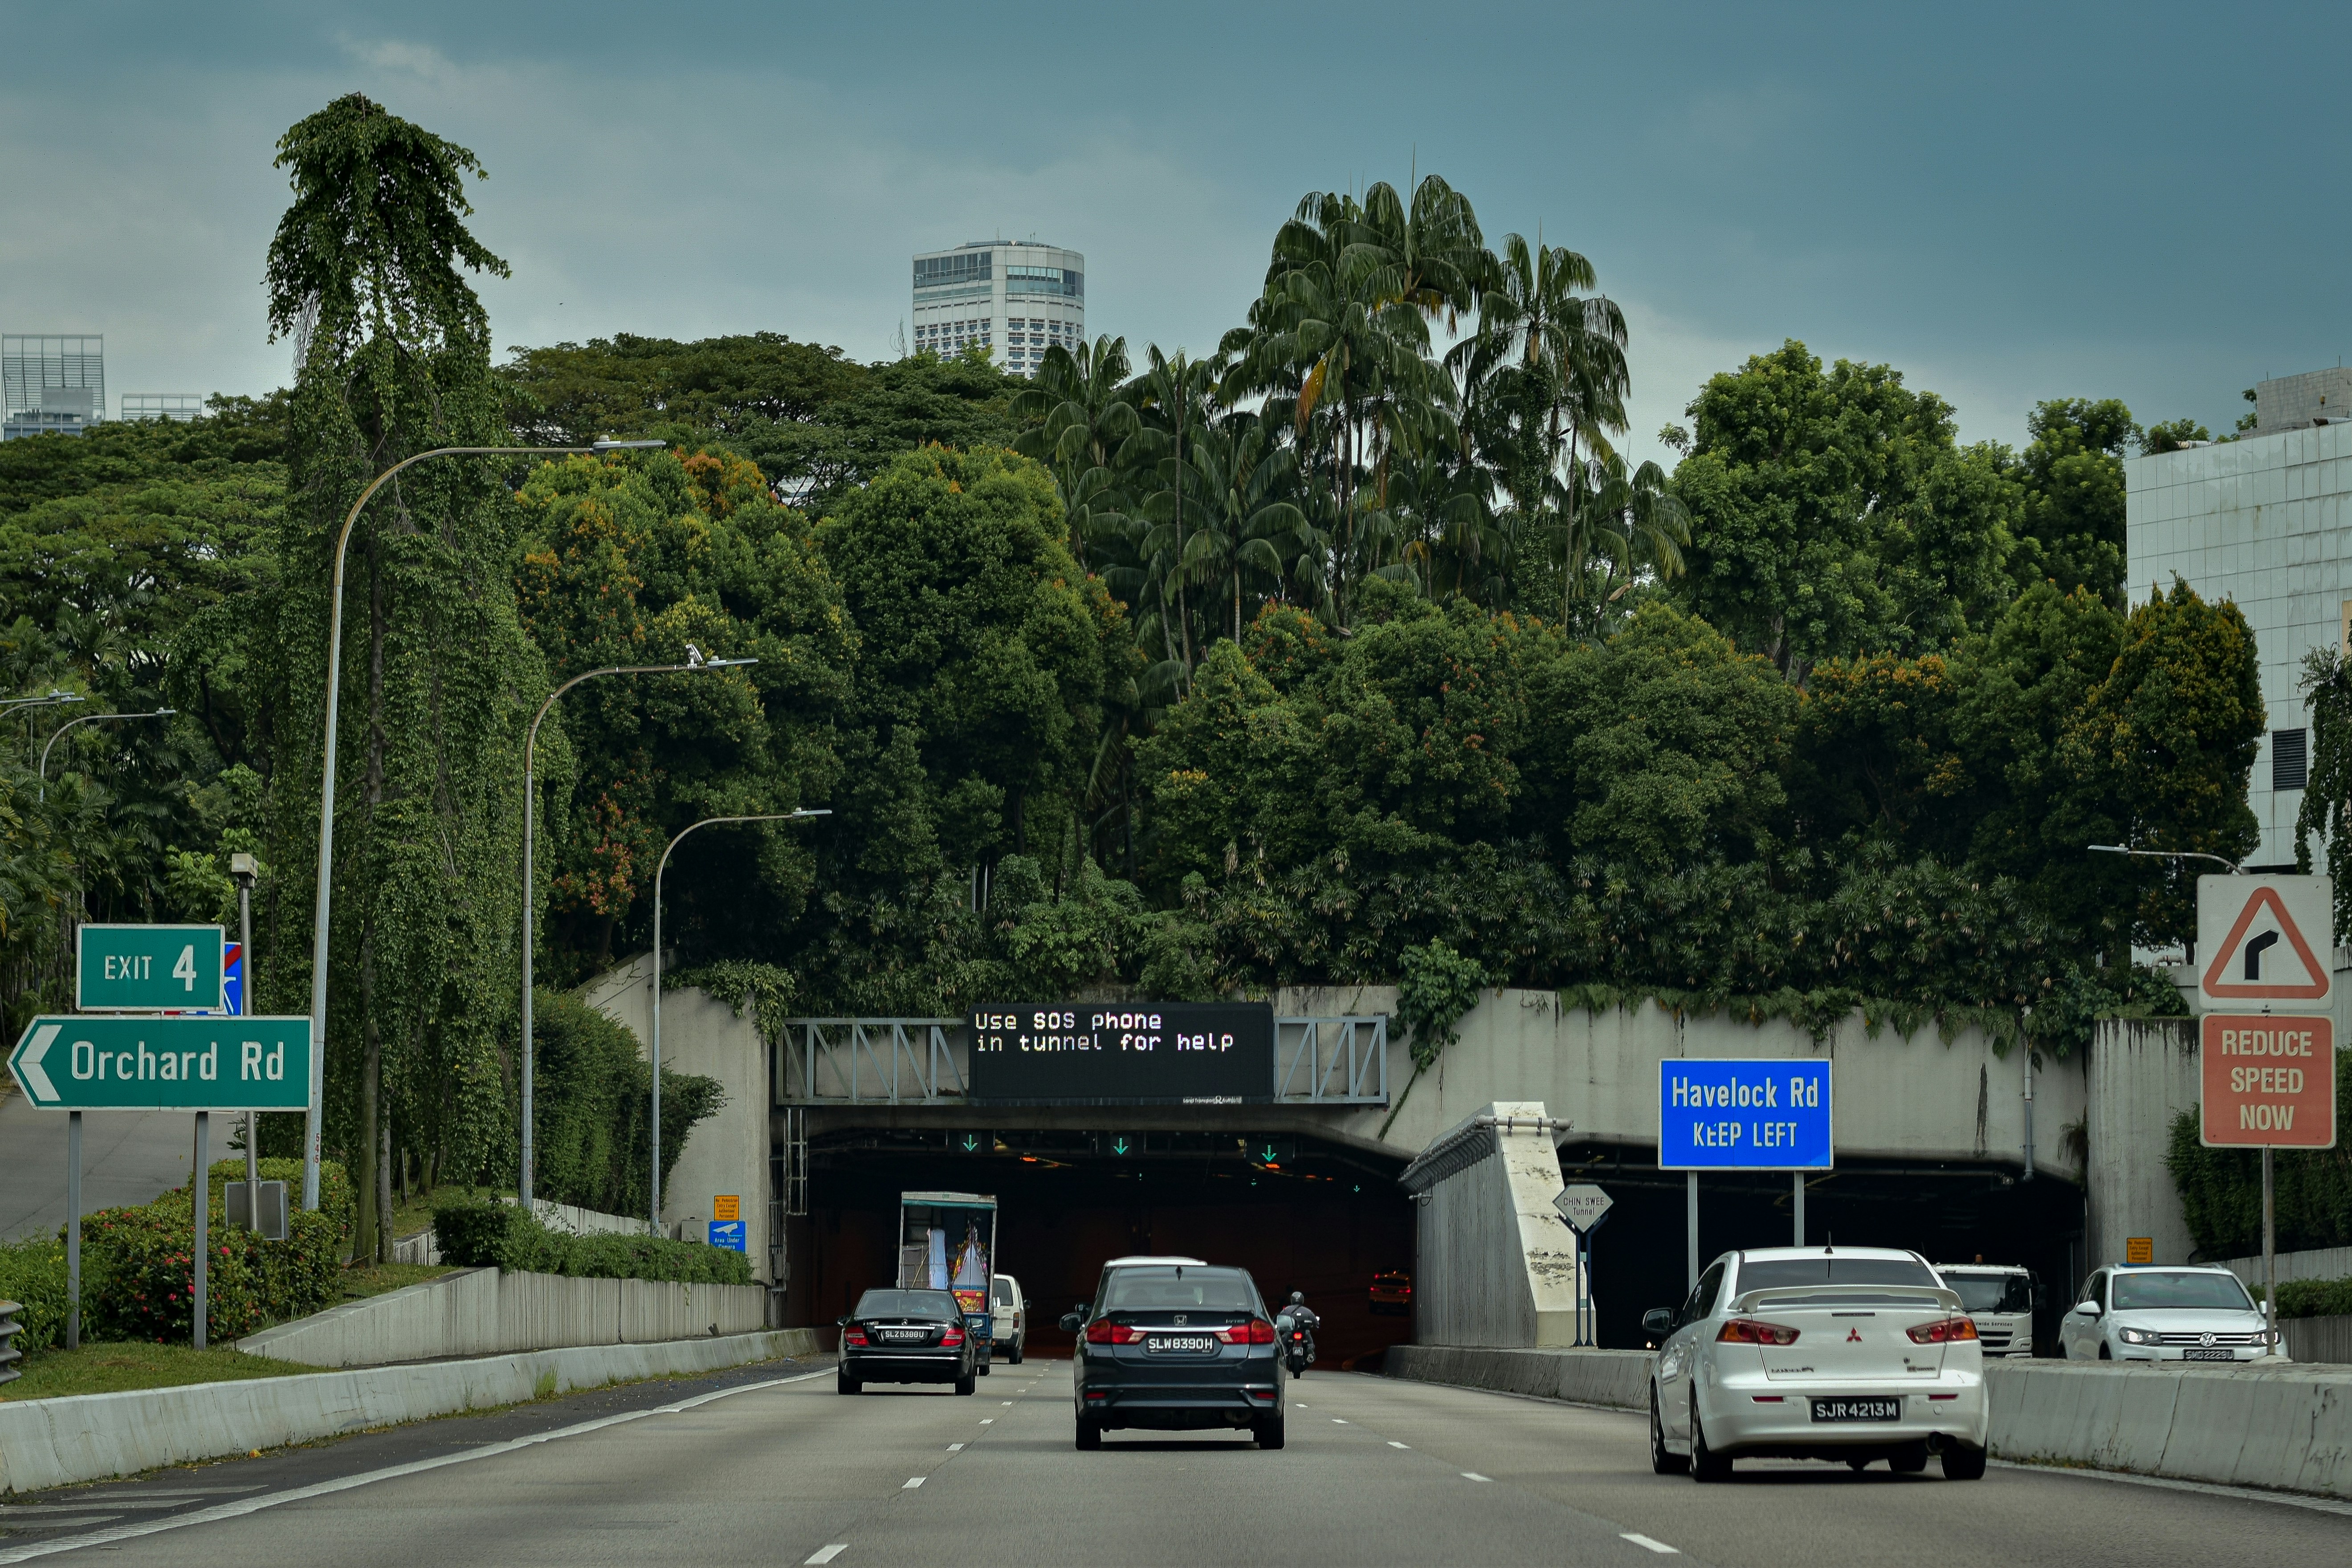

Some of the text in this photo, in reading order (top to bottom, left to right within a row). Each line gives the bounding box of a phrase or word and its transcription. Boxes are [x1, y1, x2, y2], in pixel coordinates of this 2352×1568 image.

[105, 944, 196, 991] EXIT 4
[975, 1012, 1161, 1030] Use SOS phone
[978, 1033, 1233, 1052] in tunnel for help
[2222, 1029, 2313, 1057] REDUCE
[71, 1041, 284, 1081] Orchard Rd
[1672, 1076, 1818, 1108] Havelock Rd
[2230, 1067, 2304, 1094] SPEED
[2240, 1104, 2295, 1131] NOW
[1694, 1122, 1797, 1147] KEEP LEFT
[1563, 1197, 1604, 1206] CHIN SWEE
[1573, 1207, 1594, 1215] Tunnel
[1148, 1338, 1213, 1349] SLW8390H
[1817, 1403, 1896, 1417] SJR4213M
